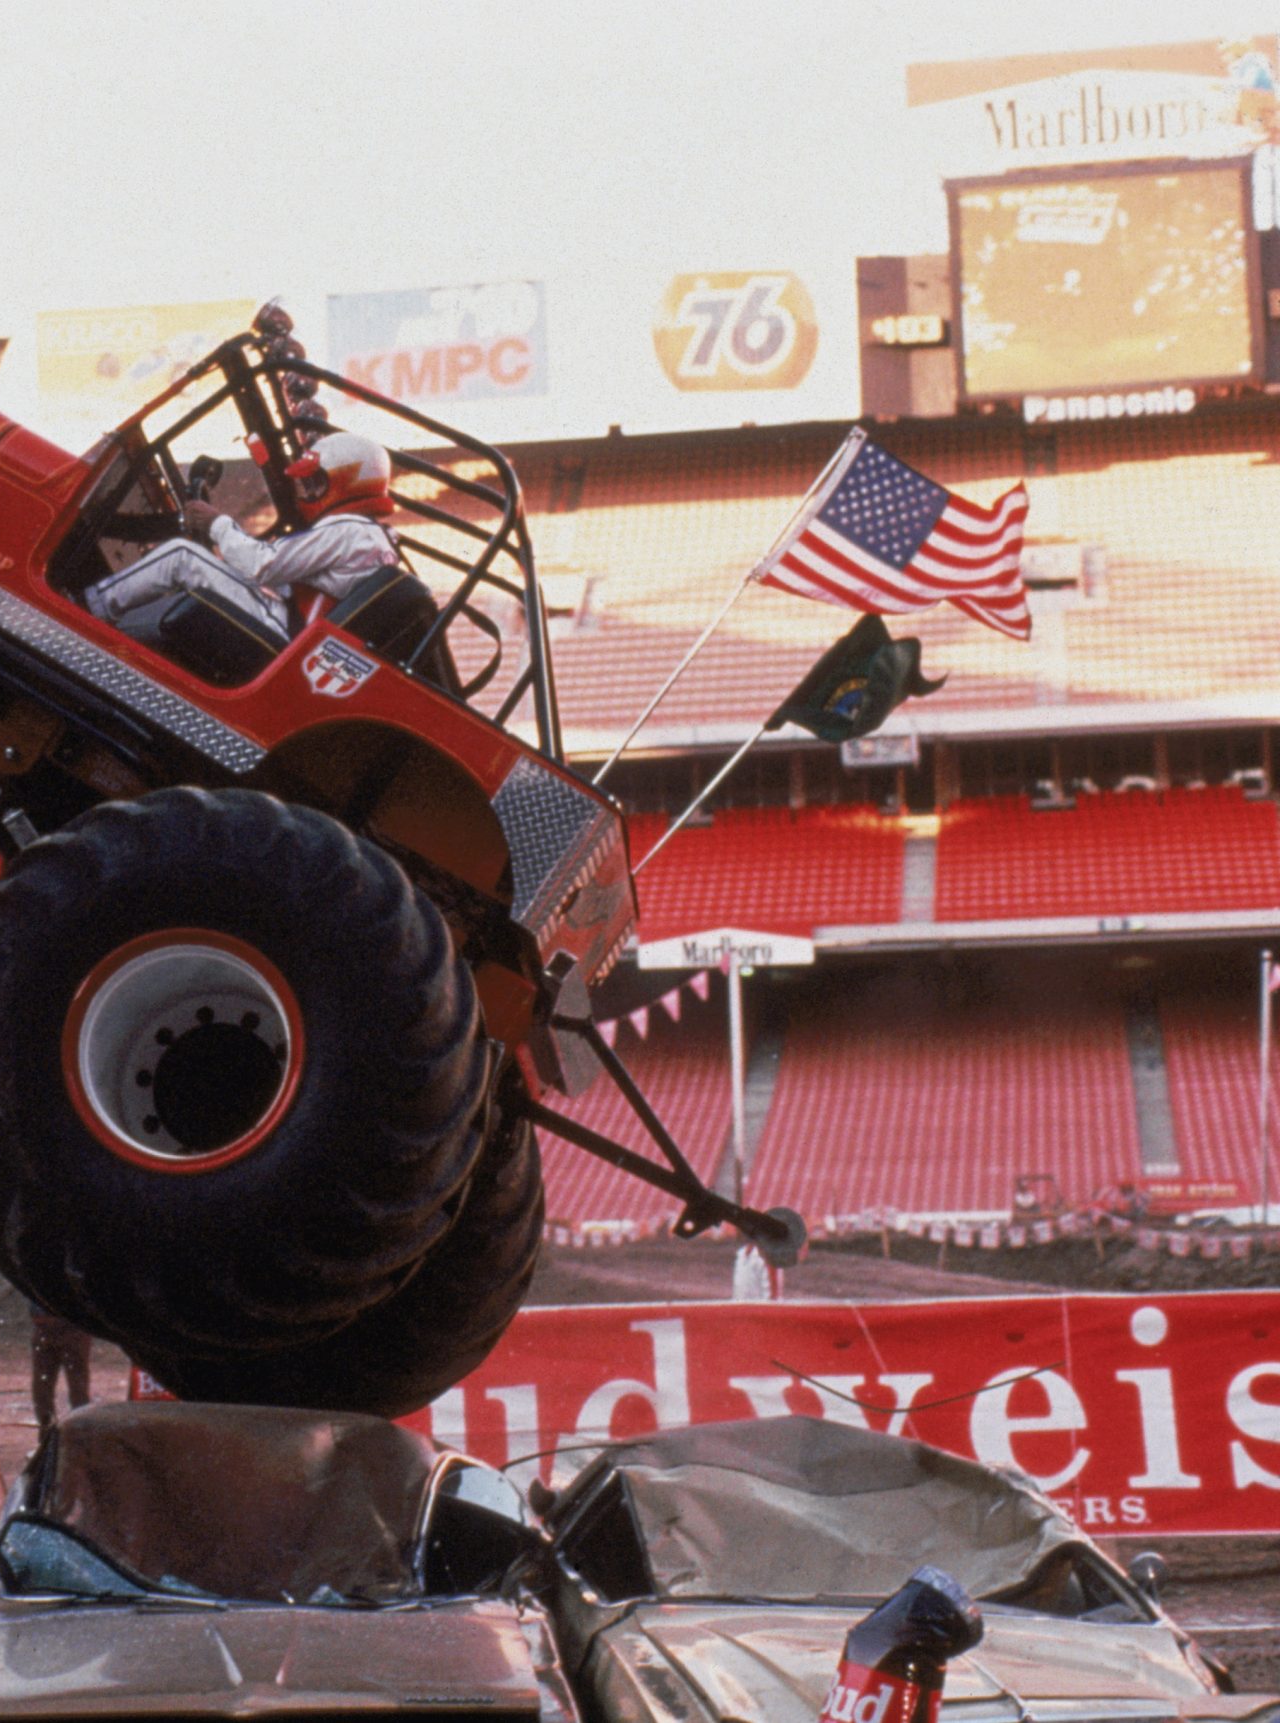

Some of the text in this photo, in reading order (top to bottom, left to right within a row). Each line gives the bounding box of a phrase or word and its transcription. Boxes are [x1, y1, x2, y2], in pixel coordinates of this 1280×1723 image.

[984, 84, 1208, 152] Marlboro
[686, 276, 796, 374] 76
[343, 336, 535, 406] KMPC
[1023, 386, 1196, 424] Panasonic
